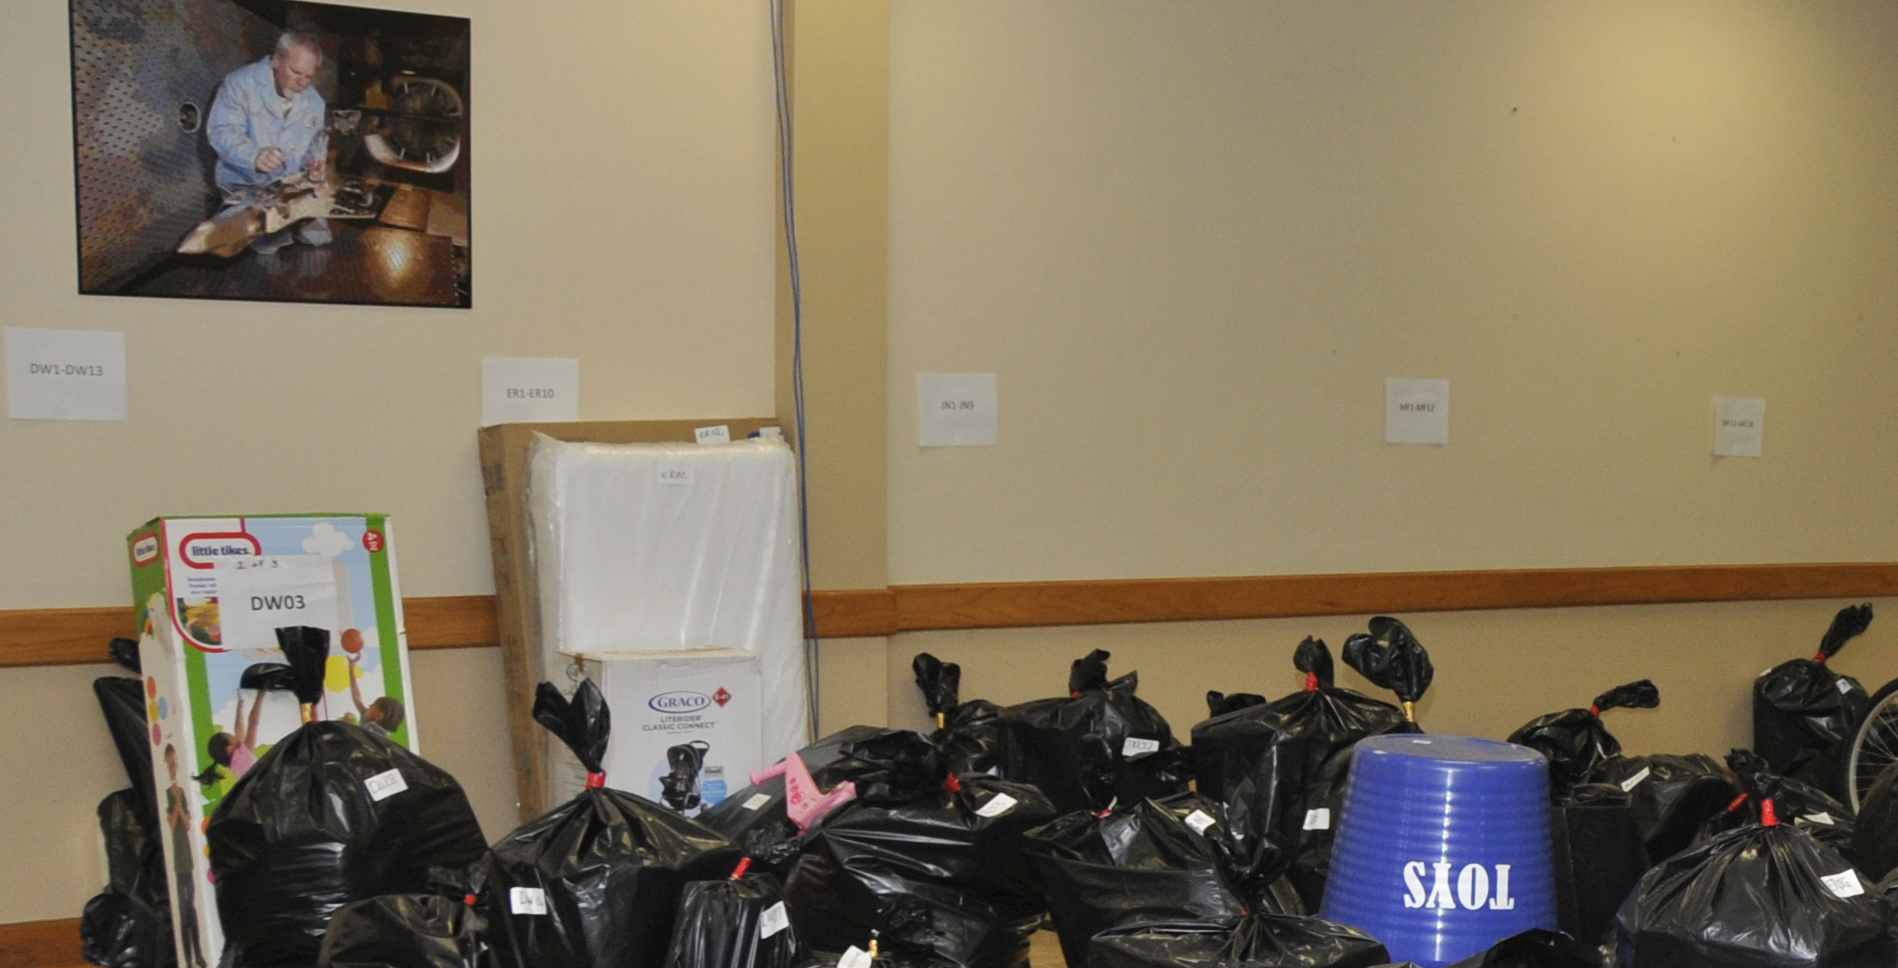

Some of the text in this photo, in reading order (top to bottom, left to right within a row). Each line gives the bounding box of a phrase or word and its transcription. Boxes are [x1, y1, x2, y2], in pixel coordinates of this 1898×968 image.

[30, 363, 104, 376] DW1-DW13
[507, 388, 555, 398] ER1-ER10
[192, 545, 248, 556] little tikes
[251, 595, 306, 611] DW03
[657, 696, 705, 708] GRACO
[661, 715, 702, 723] LITERIDER
[643, 722, 715, 731] CLASSIC CONNECT
[1403, 861, 1515, 911] TOYS
